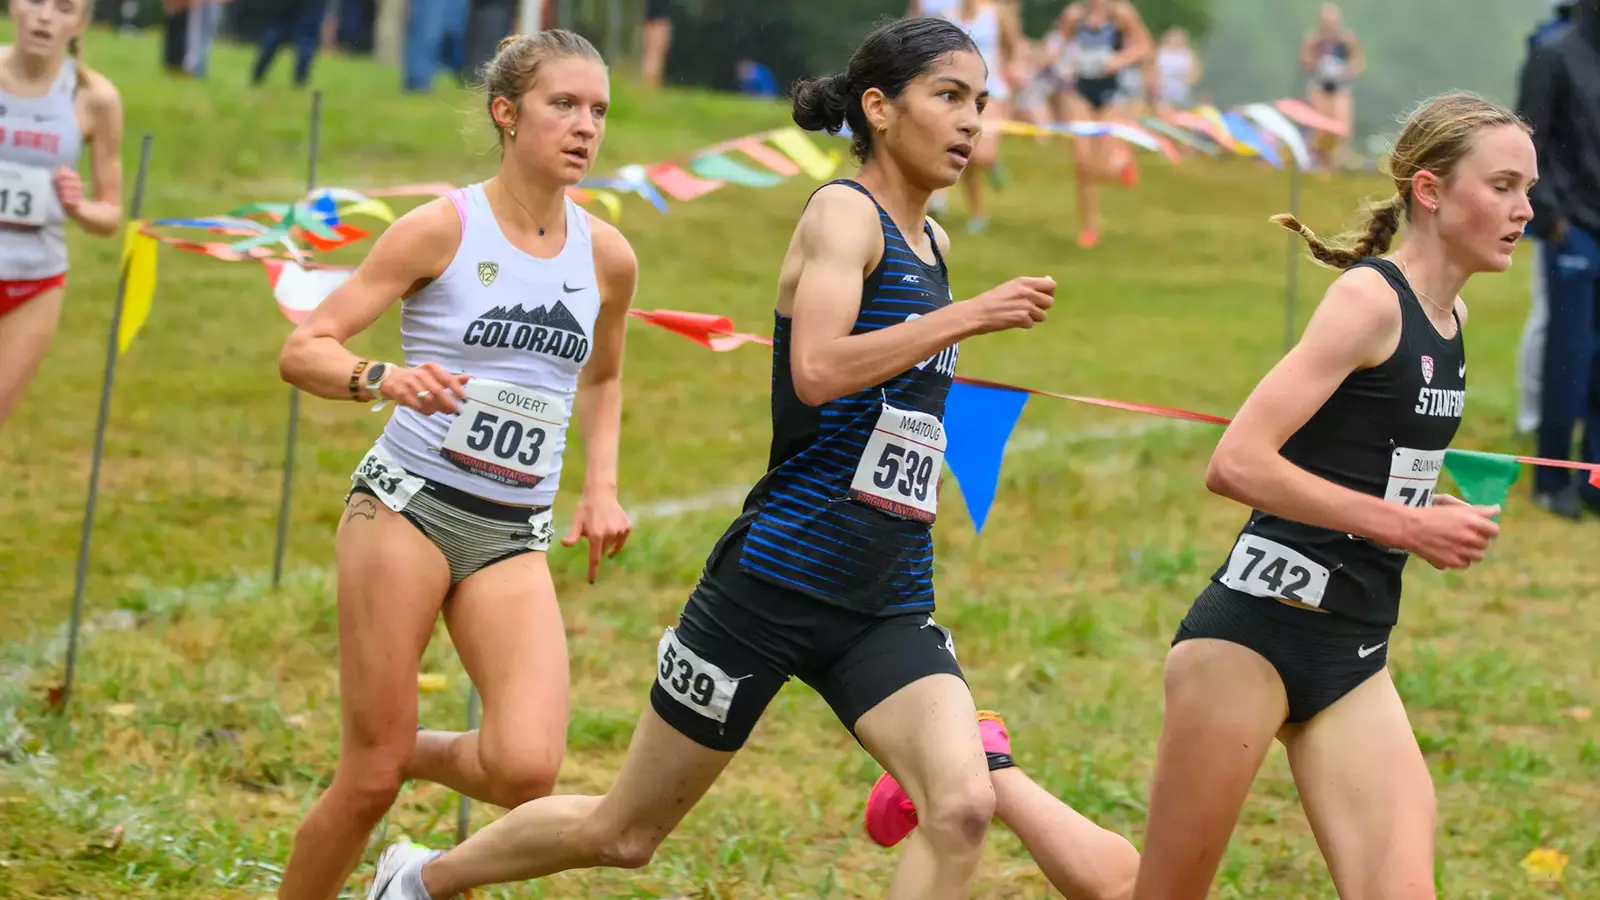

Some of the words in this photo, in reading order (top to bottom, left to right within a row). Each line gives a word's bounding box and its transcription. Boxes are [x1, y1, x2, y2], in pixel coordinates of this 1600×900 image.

[482, 272, 492, 281] 12
[902, 274, 920, 283] ACC
[462, 319, 589, 364] COLORADO
[497, 390, 549, 414] COVERT
[466, 410, 546, 466] 503
[900, 416, 941, 440] MAATOUG
[449, 451, 487, 470] VIRGINIA
[873, 442, 933, 502] 539
[857, 492, 893, 511] VIRGINIA
[1239, 546, 1312, 602] 742
[660, 642, 715, 707] 539
